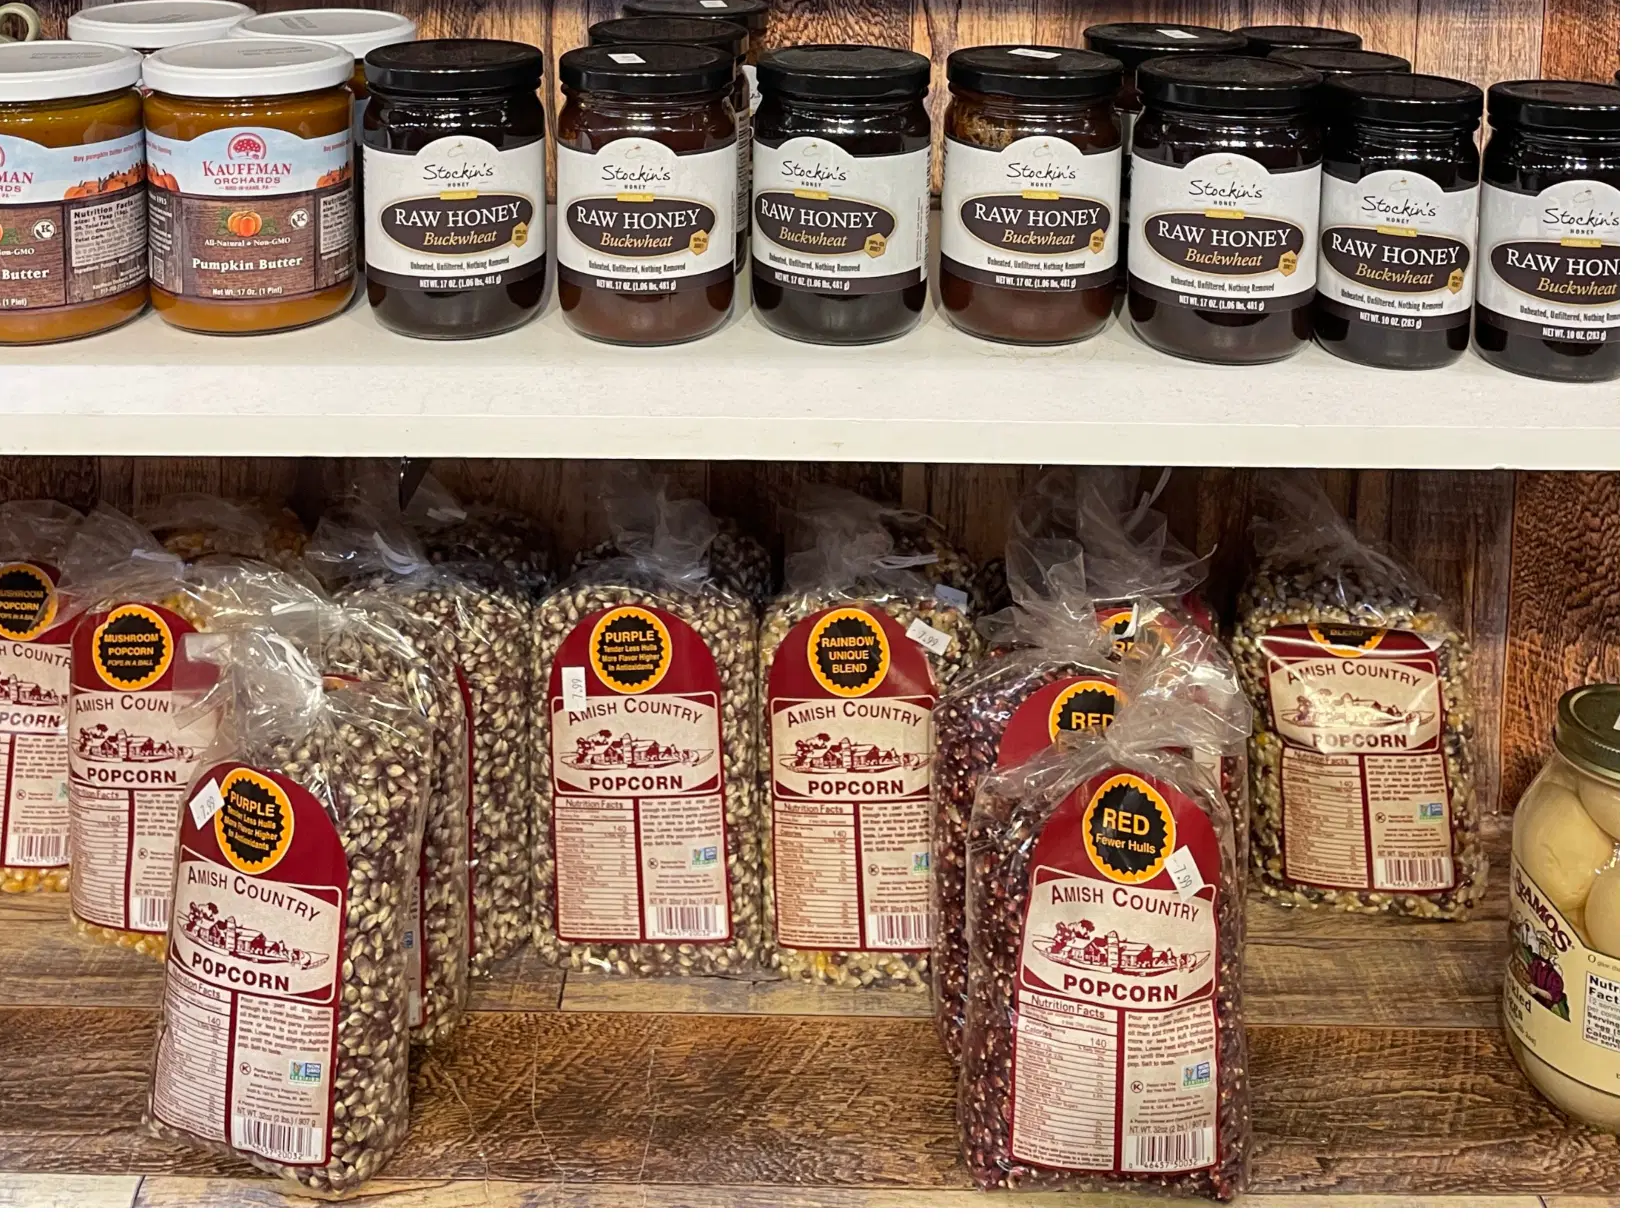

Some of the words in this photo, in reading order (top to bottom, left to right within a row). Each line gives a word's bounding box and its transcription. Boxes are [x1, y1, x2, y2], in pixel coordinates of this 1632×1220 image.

[202, 161, 293, 177] KAUFFMAN
[423, 163, 493, 180] Stockin's
[601, 164, 671, 182] Stockin's
[781, 160, 847, 181] Stockin's
[1006, 162, 1076, 180] Stockin's
[214, 177, 281, 185] ORCHARDS
[1189, 180, 1263, 199] Stockin's
[74, 206, 113, 219] Nutrition
[395, 208, 441, 227] RAW
[447, 201, 521, 227] HONEY
[761, 198, 795, 222] RAW
[799, 208, 878, 228] HONEY
[974, 203, 1023, 225] RAW
[1028, 207, 1101, 227] HONEY
[1361, 195, 1436, 217] Stockin's
[577, 205, 618, 228] RAW
[623, 208, 701, 230] HONEY
[1543, 208, 1620, 227] Stockin's
[204, 239, 245, 247] All-Natural
[254, 237, 291, 246] Non-GMO
[423, 230, 497, 246] Buckwheat
[600, 232, 674, 248] Buckwheat
[778, 226, 848, 247] Buckwheat
[1002, 228, 1075, 245] Buckwheat
[1158, 220, 1205, 244] RAW
[1211, 229, 1291, 248] HONEY
[1185, 248, 1264, 267] Buckwheat
[1332, 232, 1378, 258] RAW
[1382, 245, 1460, 265] HONEY
[192, 258, 254, 272] Pumpkin
[259, 256, 303, 270] Butter
[489, 256, 510, 267] Removed
[1506, 248, 1561, 273] RAW
[1566, 257, 1620, 276] HON
[2, 268, 49, 280] Butter
[1356, 263, 1434, 285] Buckwheat
[1537, 277, 1617, 296] Buckwheat
[104, 633, 159, 643] MUSHROOM
[605, 630, 655, 643] PURPLE
[822, 636, 874, 648] RAINBOW
[108, 646, 154, 656] POPCORN
[625, 644, 640, 652] Less
[829, 651, 869, 660] UNIQUE
[619, 654, 638, 662] Flavor
[639, 653, 660, 662] Higher
[832, 664, 867, 674] BLEND
[1287, 661, 1336, 685] AMISH
[1342, 661, 1421, 687] COUNTRY
[76, 697, 114, 714] AMISH
[568, 703, 617, 726] AMISH
[624, 698, 703, 725] COUNTRY
[787, 705, 836, 728] AMISH
[843, 701, 922, 728] COUNTRY
[1312, 734, 1407, 748] POPCORN
[87, 767, 176, 784] POPCORN
[590, 775, 683, 791] POPCORN
[808, 780, 904, 795] POPCORN
[230, 790, 275, 817] PURPLE
[1102, 808, 1150, 836] RED
[1096, 833, 1126, 849] Fewer
[1128, 840, 1157, 854] Hulls
[187, 865, 228, 890] AMISH
[234, 876, 321, 922] COUNTRY
[1052, 885, 1104, 905] AMISH
[1113, 888, 1200, 922] COUNTRY
[191, 951, 290, 992] POPCORN
[1063, 974, 1178, 1002] POPCORN
[1031, 995, 1075, 1013] Nutrition
[1076, 1005, 1105, 1019] Facts
